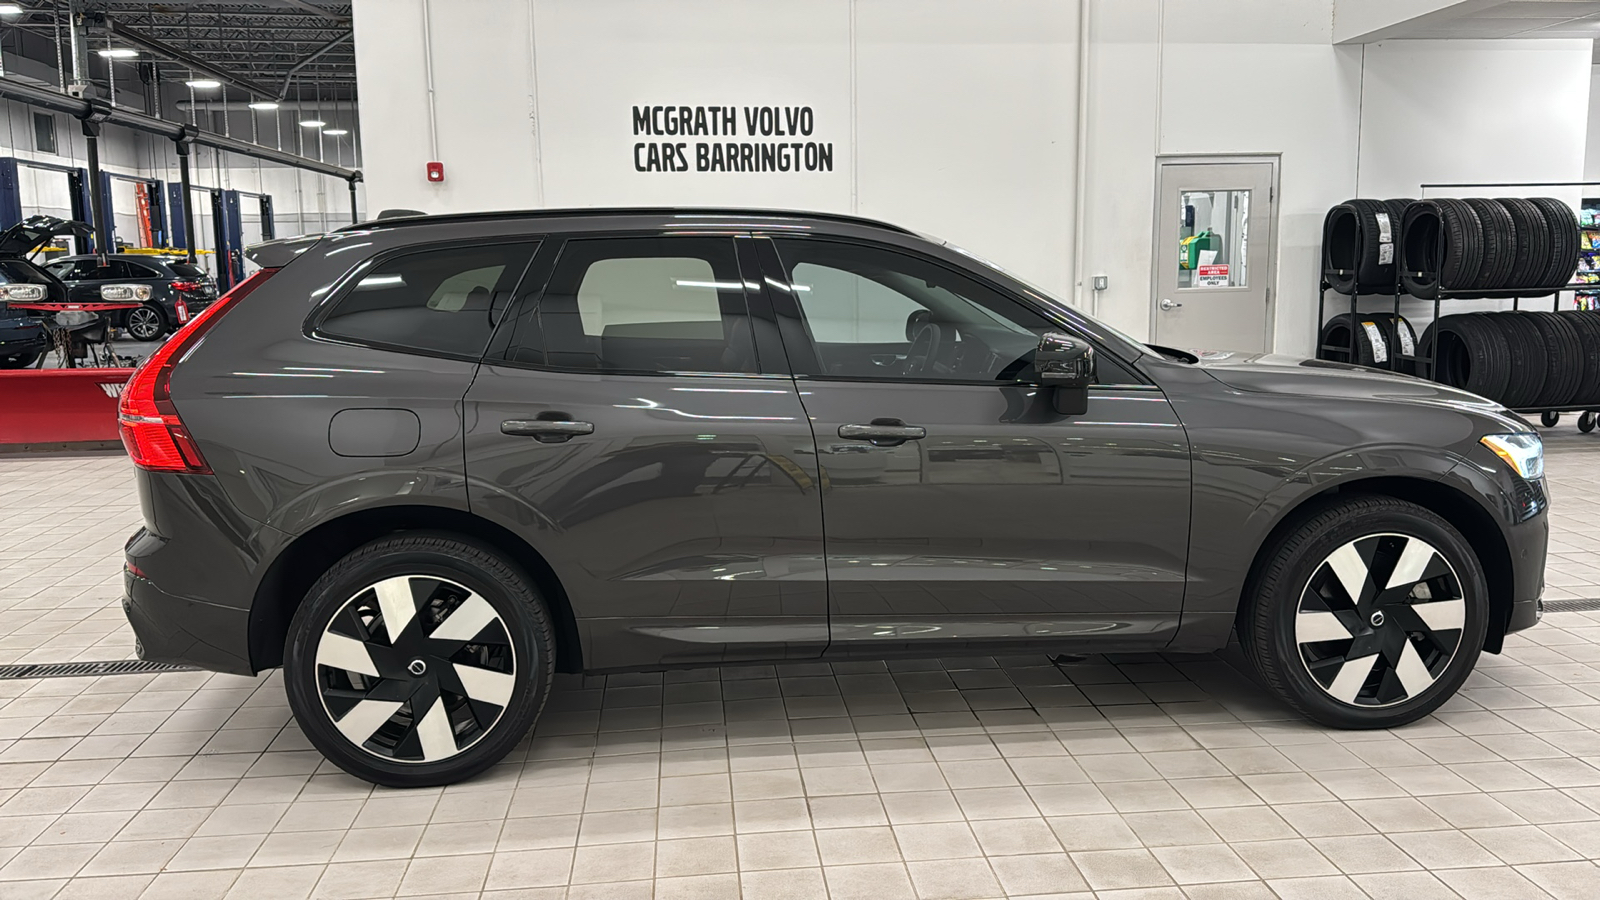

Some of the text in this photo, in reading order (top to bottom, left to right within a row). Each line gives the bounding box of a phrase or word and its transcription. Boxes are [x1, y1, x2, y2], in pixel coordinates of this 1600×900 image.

[632, 106, 813, 136] MCGRATH VOLVO
[634, 142, 833, 172] CARS BARRINGTON
